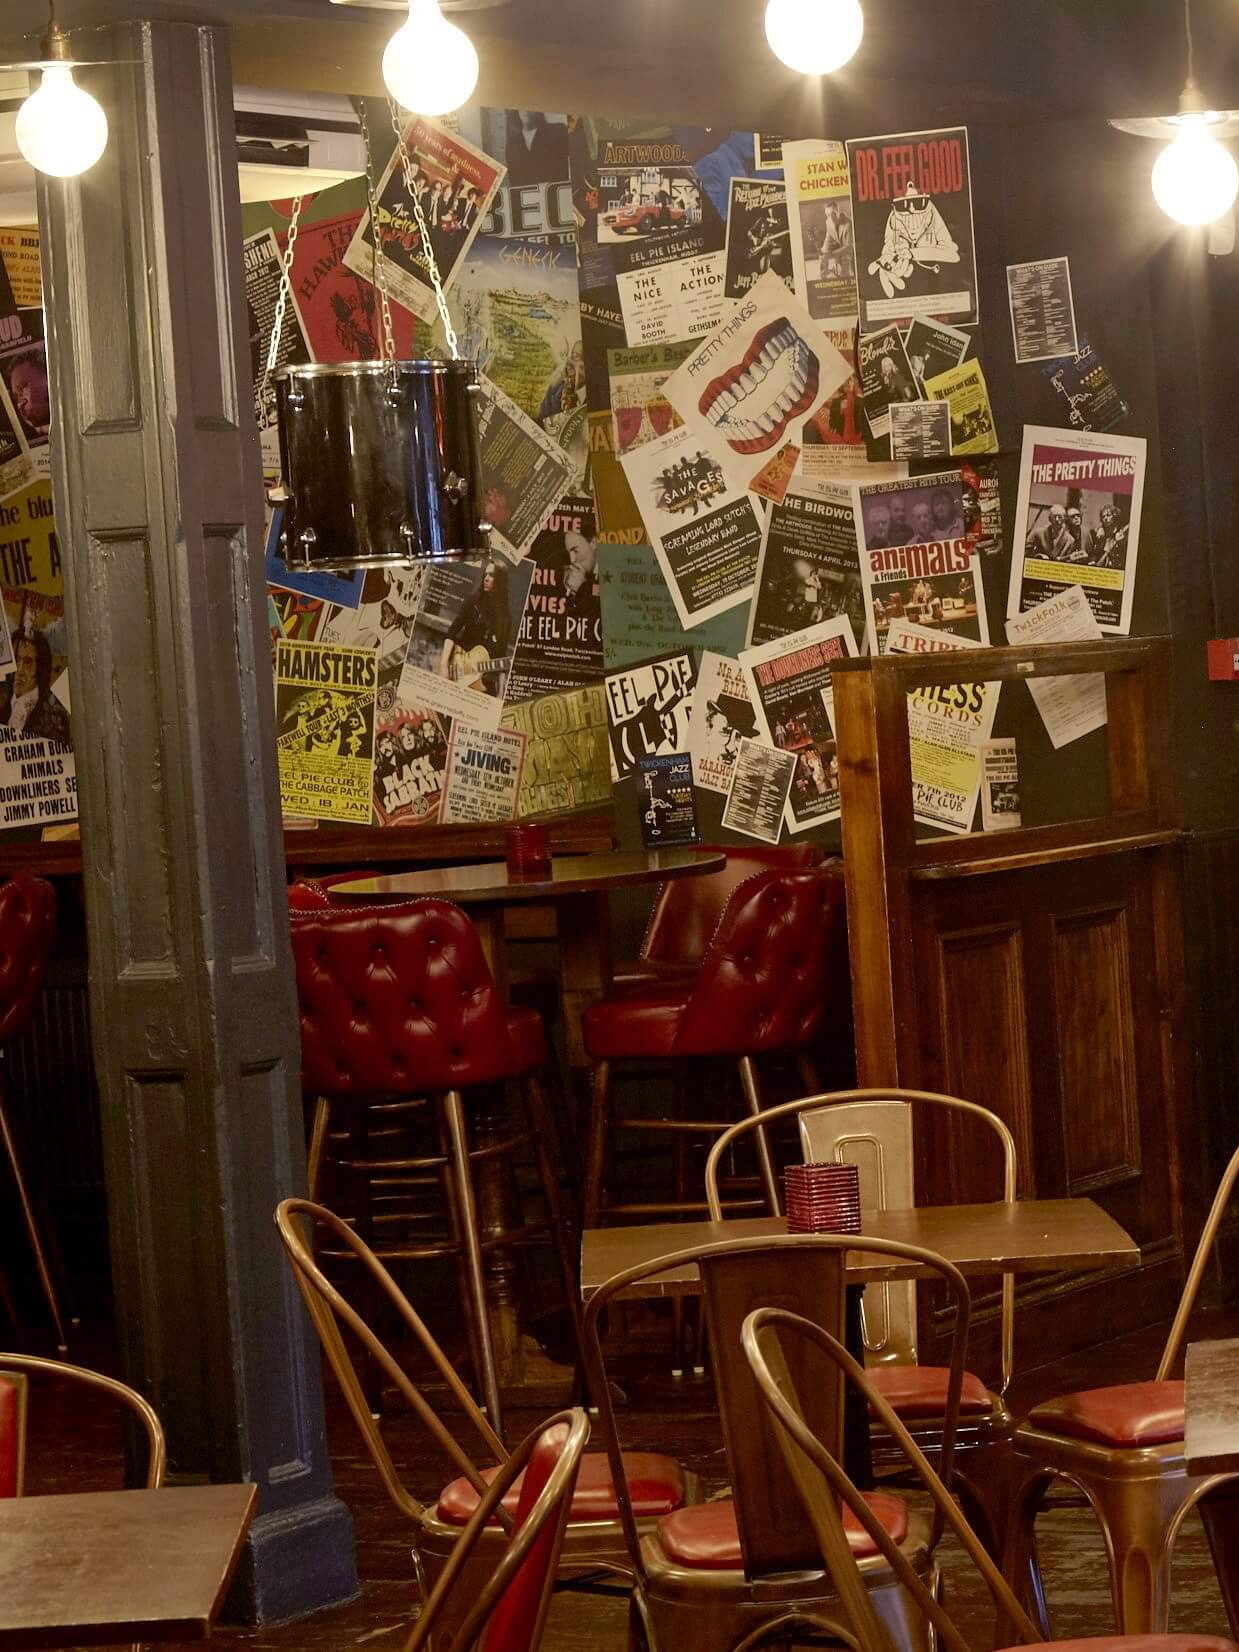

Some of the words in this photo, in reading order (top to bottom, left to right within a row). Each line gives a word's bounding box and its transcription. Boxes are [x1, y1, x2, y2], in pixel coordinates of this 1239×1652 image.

[807, 162, 834, 175] STAN
[918, 138, 962, 193] GOOD
[800, 175, 849, 191] CHICKEN
[630, 251, 645, 263] EEL
[649, 247, 664, 258] PIE
[667, 238, 704, 255] ISLAND
[690, 264, 712, 277] THE
[635, 277, 656, 289] THE
[680, 273, 724, 292] ACTION
[634, 288, 662, 302] NICE
[641, 320, 664, 331] DAVID
[641, 329, 666, 340] BOOTH
[687, 333, 725, 376] PRETTY
[722, 301, 758, 339] THINGS
[932, 331, 949, 343] John
[678, 467, 698, 480] THE
[1032, 463, 1053, 483] THE
[1055, 461, 1095, 481] PRETTY
[1097, 456, 1137, 476] THINGS
[664, 471, 723, 504] SAVAGES
[862, 486, 877, 496] THE
[877, 480, 918, 493] GREATEST
[920, 476, 937, 487] HITS
[939, 473, 961, 485] TOUR
[0, 504, 20, 527] he
[27, 496, 54, 520] blu
[557, 503, 571, 511] 2th
[785, 496, 802, 510] HE
[805, 501, 853, 521] BIRDWO
[664, 526, 704, 551] SCREAMING
[704, 517, 723, 532] LORD
[685, 532, 720, 555] LEGENDARY
[719, 524, 738, 539] BAND
[783, 546, 817, 560] THURSDAY
[823, 555, 842, 565] APRIL
[533, 568, 556, 586] RIL
[518, 616, 533, 640] HE
[538, 616, 560, 640] EEL
[279, 648, 376, 687] HAMSTERS
[607, 677, 646, 719] EEL
[277, 728, 306, 748] FAREWELL
[482, 732, 502, 742] ISLAND
[4, 742, 46, 763] GRAHAM
[461, 749, 511, 775] JIVING
[21, 759, 64, 780] ANIMALS
[669, 764, 689, 774] JAZZ
[699, 759, 734, 778] PARAMO
[301, 773, 320, 783] PIE
[323, 776, 354, 787] CLUB
[699, 772, 718, 787] JAZZ
[720, 780, 731, 791] BA
[0, 779, 61, 804] DOWNLINERS
[65, 776, 78, 793] SE
[295, 782, 338, 795] CABBAGE
[340, 787, 369, 798] PATCH
[927, 785, 941, 794] 7th
[944, 790, 967, 802] 2012
[4, 801, 36, 822] JIMMY
[38, 796, 76, 817] POWELL
[346, 802, 369, 812] JAN
[937, 796, 963, 812] CLUB
